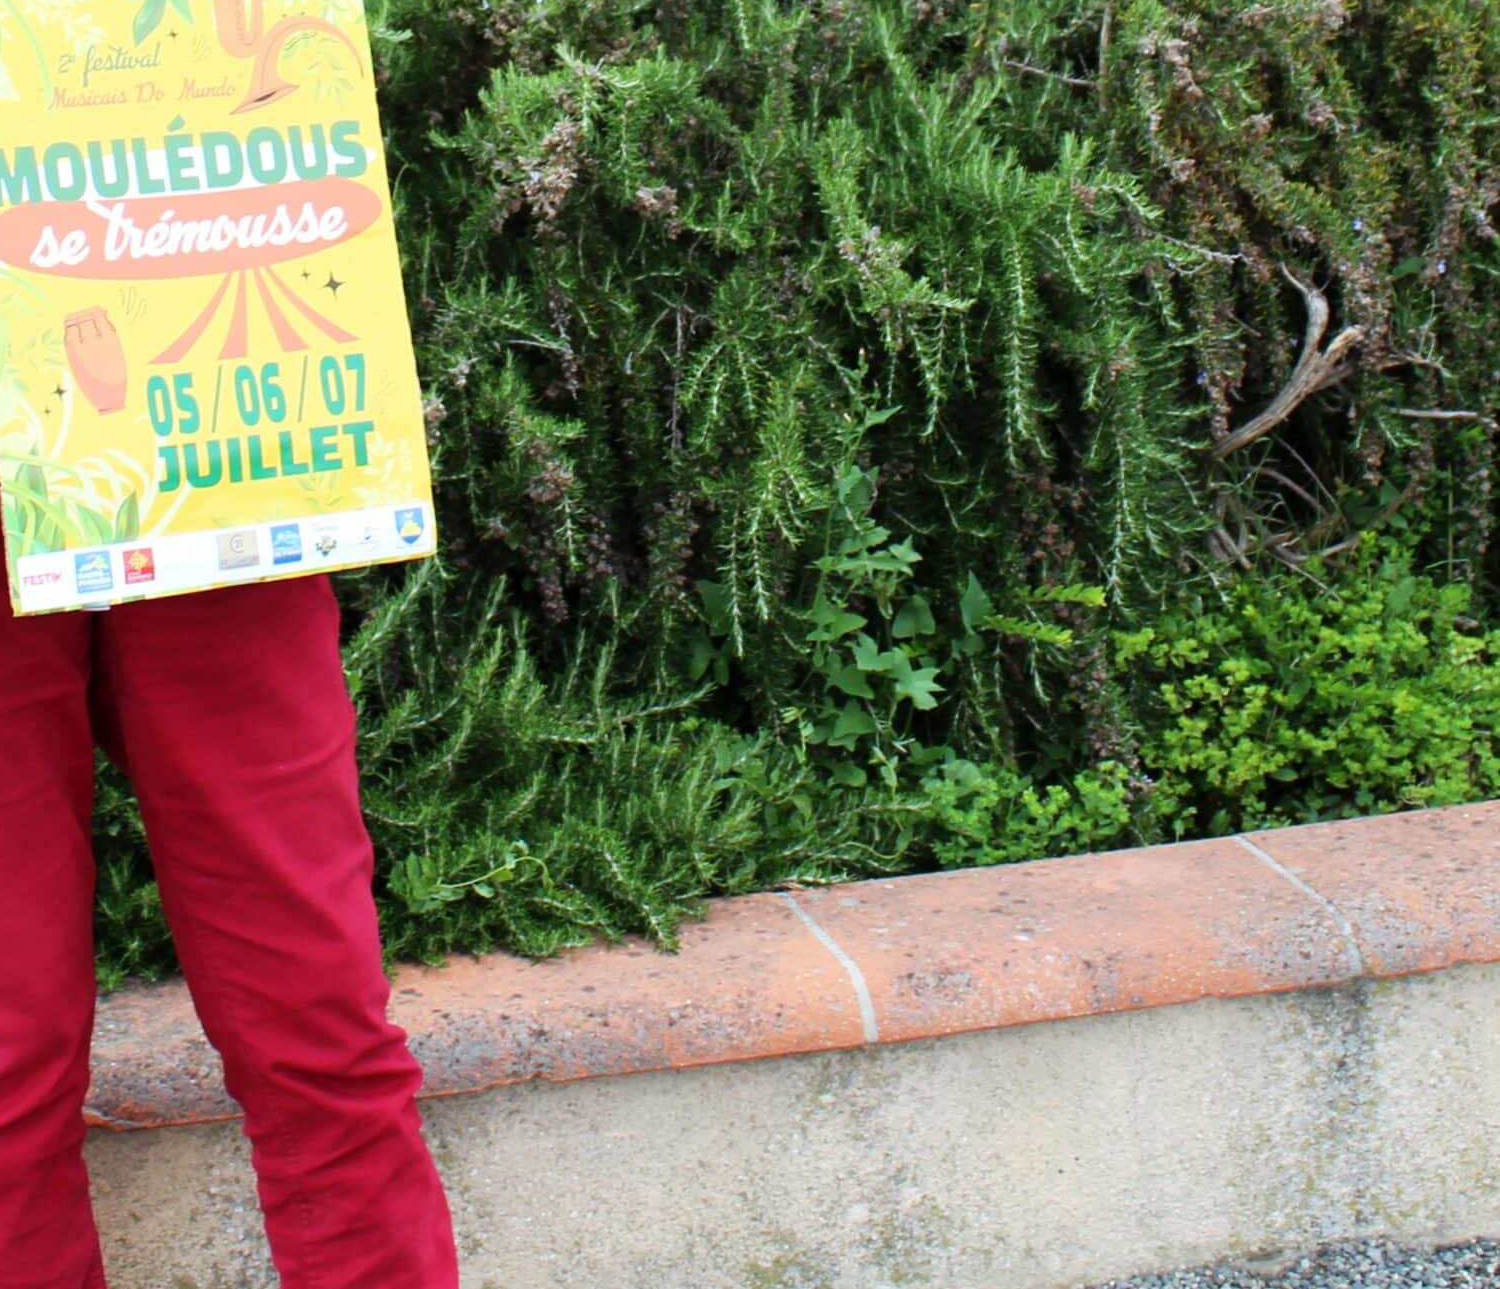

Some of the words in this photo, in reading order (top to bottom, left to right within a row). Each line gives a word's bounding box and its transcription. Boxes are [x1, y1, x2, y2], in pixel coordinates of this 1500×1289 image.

[82, 42, 161, 88] festival
[29, 225, 90, 268] se
[85, 198, 348, 262] trémousse
[158, 420, 375, 493] JUILLET
